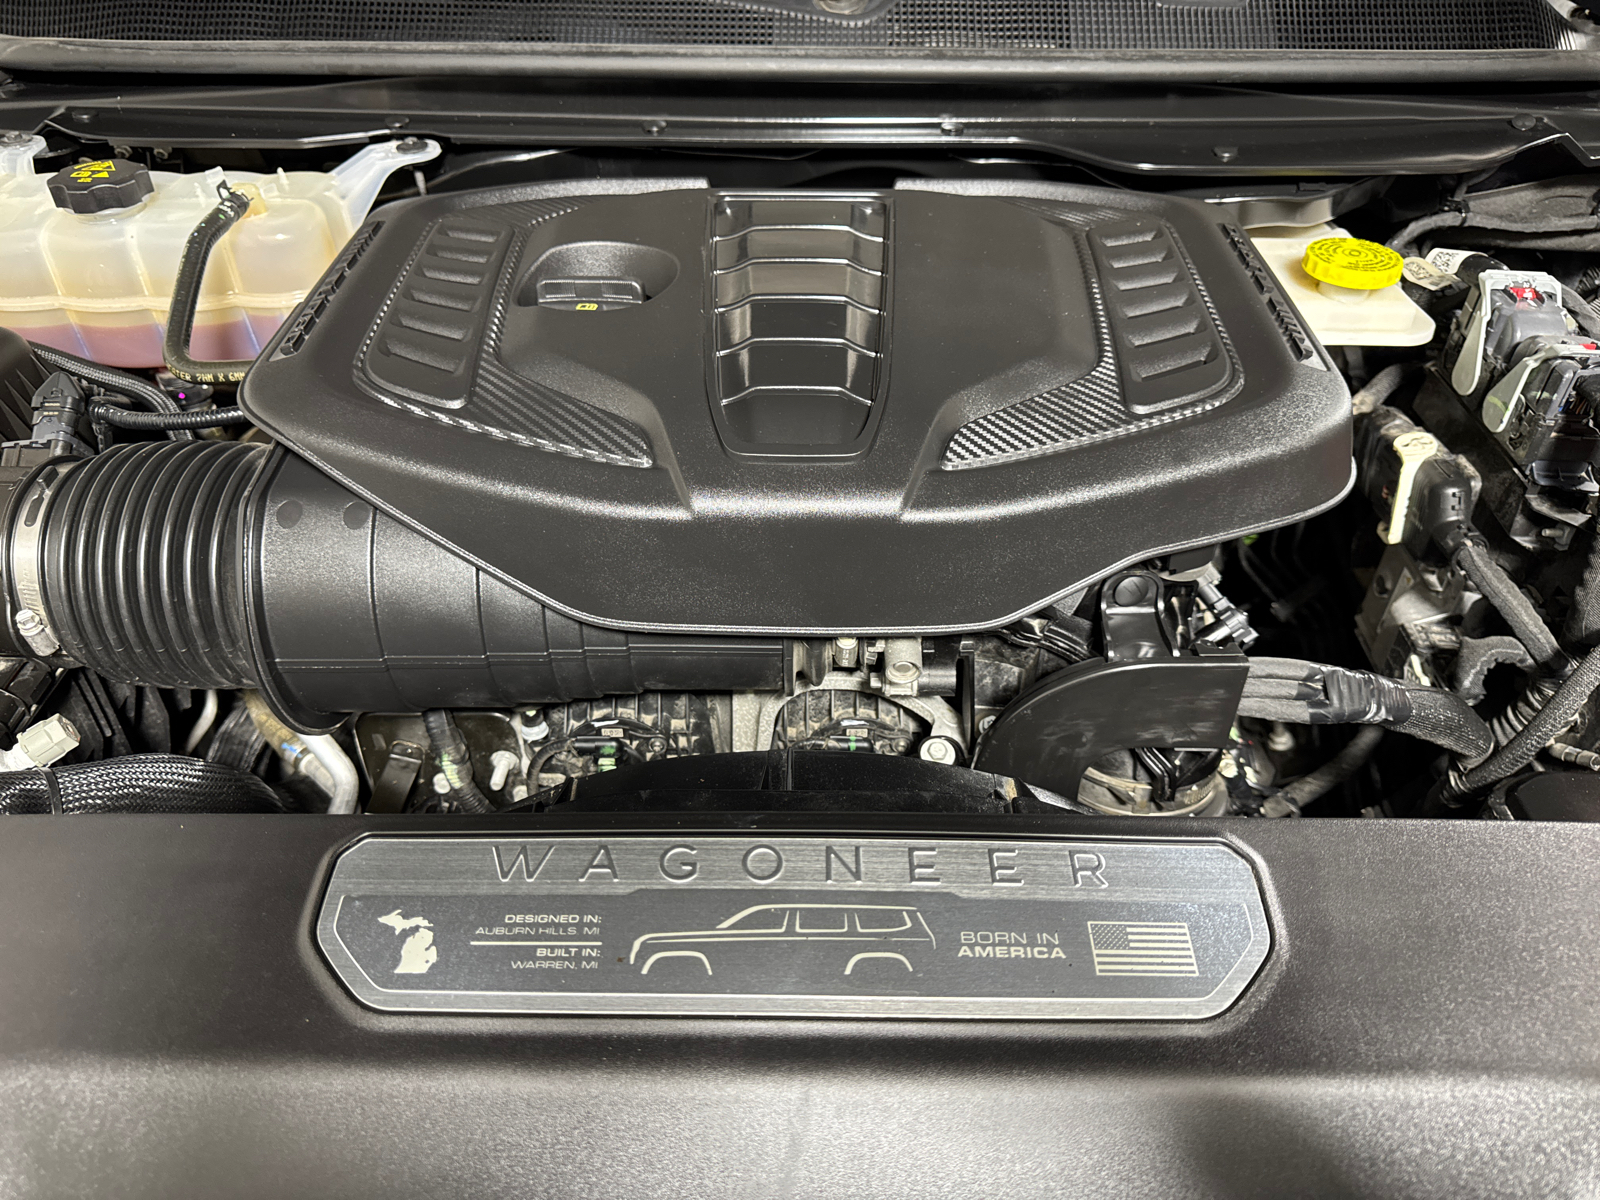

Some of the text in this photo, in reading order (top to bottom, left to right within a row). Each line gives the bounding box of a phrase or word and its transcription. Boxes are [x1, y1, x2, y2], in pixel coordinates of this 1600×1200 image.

[491, 843, 1110, 889] WAGONEER
[504, 913, 602, 924] DESIGNED IN:
[475, 927, 535, 936] AUBURN
[583, 927, 601, 937] MI
[960, 931, 1059, 945] BORN IN
[536, 947, 602, 958] BUILT IN:
[957, 945, 1067, 959] AMERICA
[582, 961, 599, 971] MI
